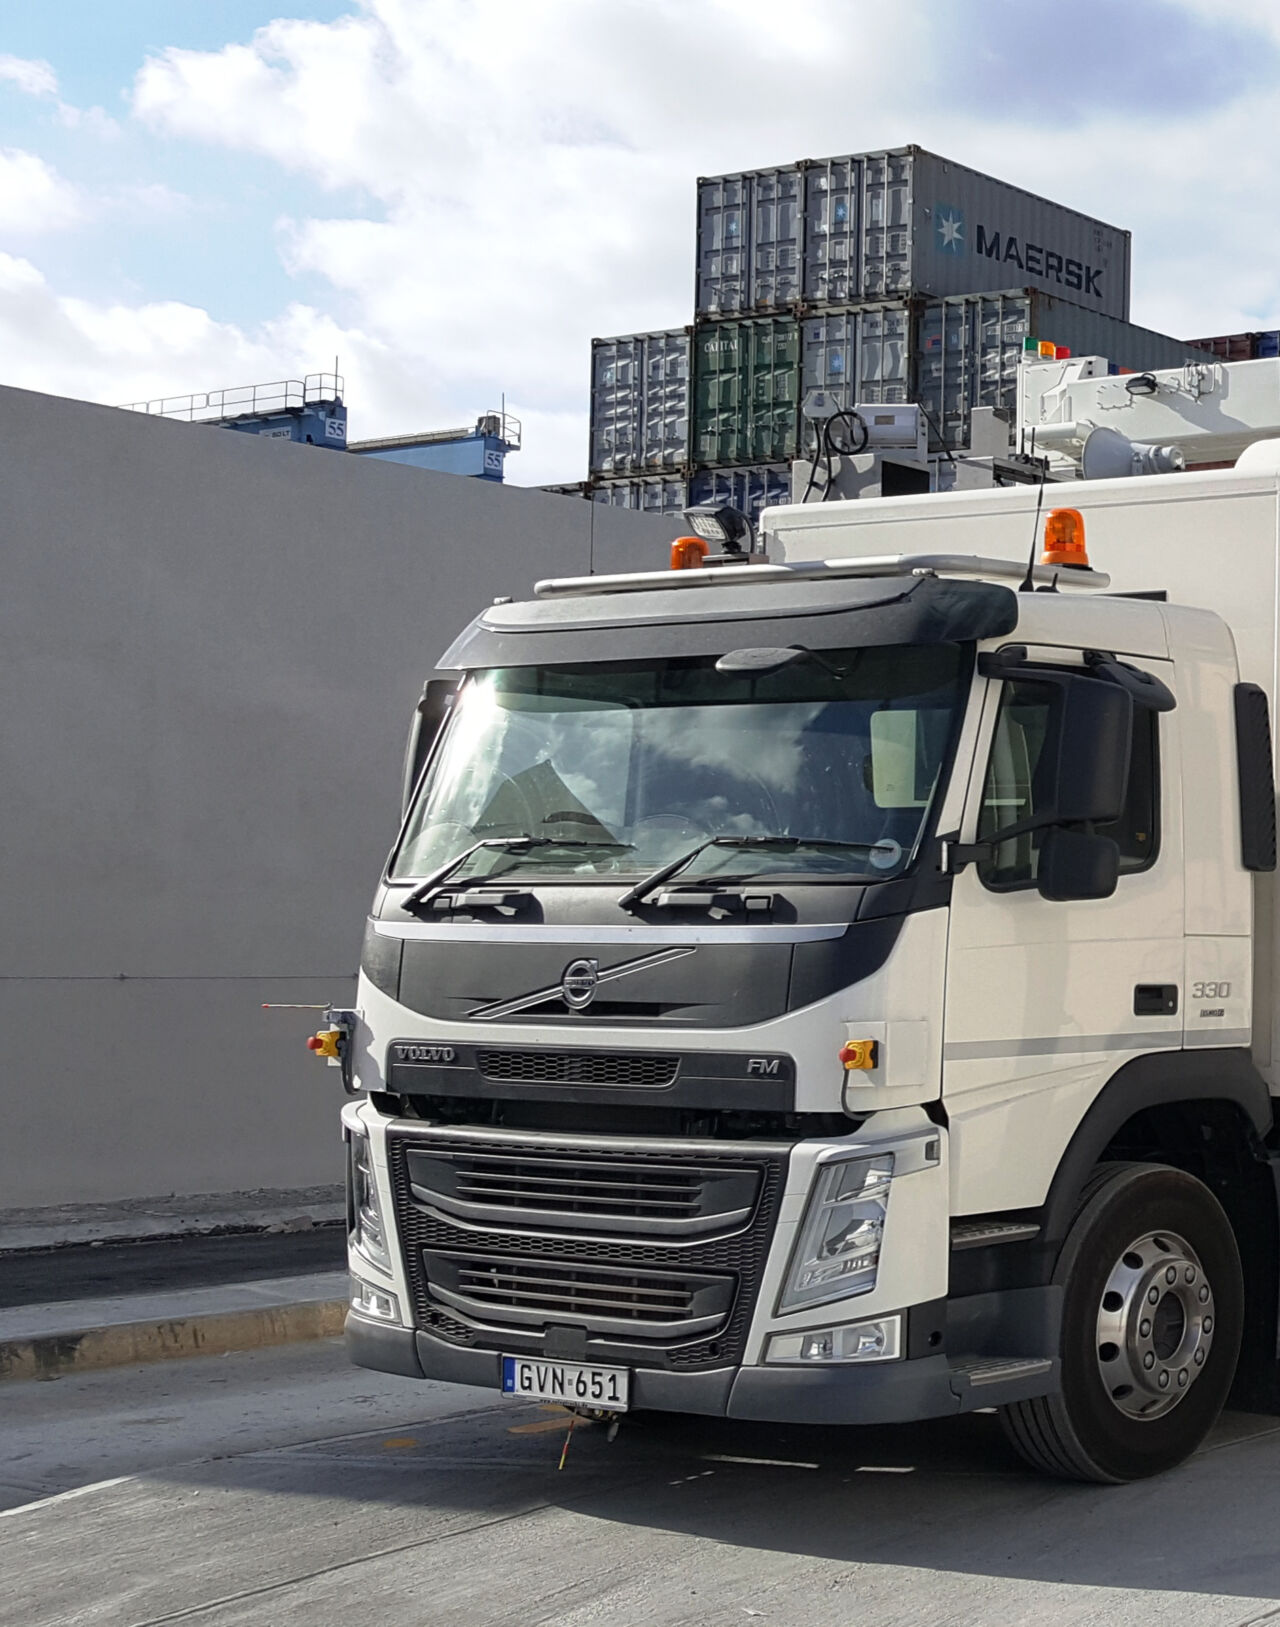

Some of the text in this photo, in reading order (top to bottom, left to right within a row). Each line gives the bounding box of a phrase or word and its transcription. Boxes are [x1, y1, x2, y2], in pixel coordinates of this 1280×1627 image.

[976, 224, 1103, 298] MAERSK
[328, 421, 344, 437] 55
[487, 452, 501, 468] 55
[1192, 981, 1232, 999] 330
[394, 1045, 455, 1062] VOLVO
[746, 1059, 780, 1075] FM
